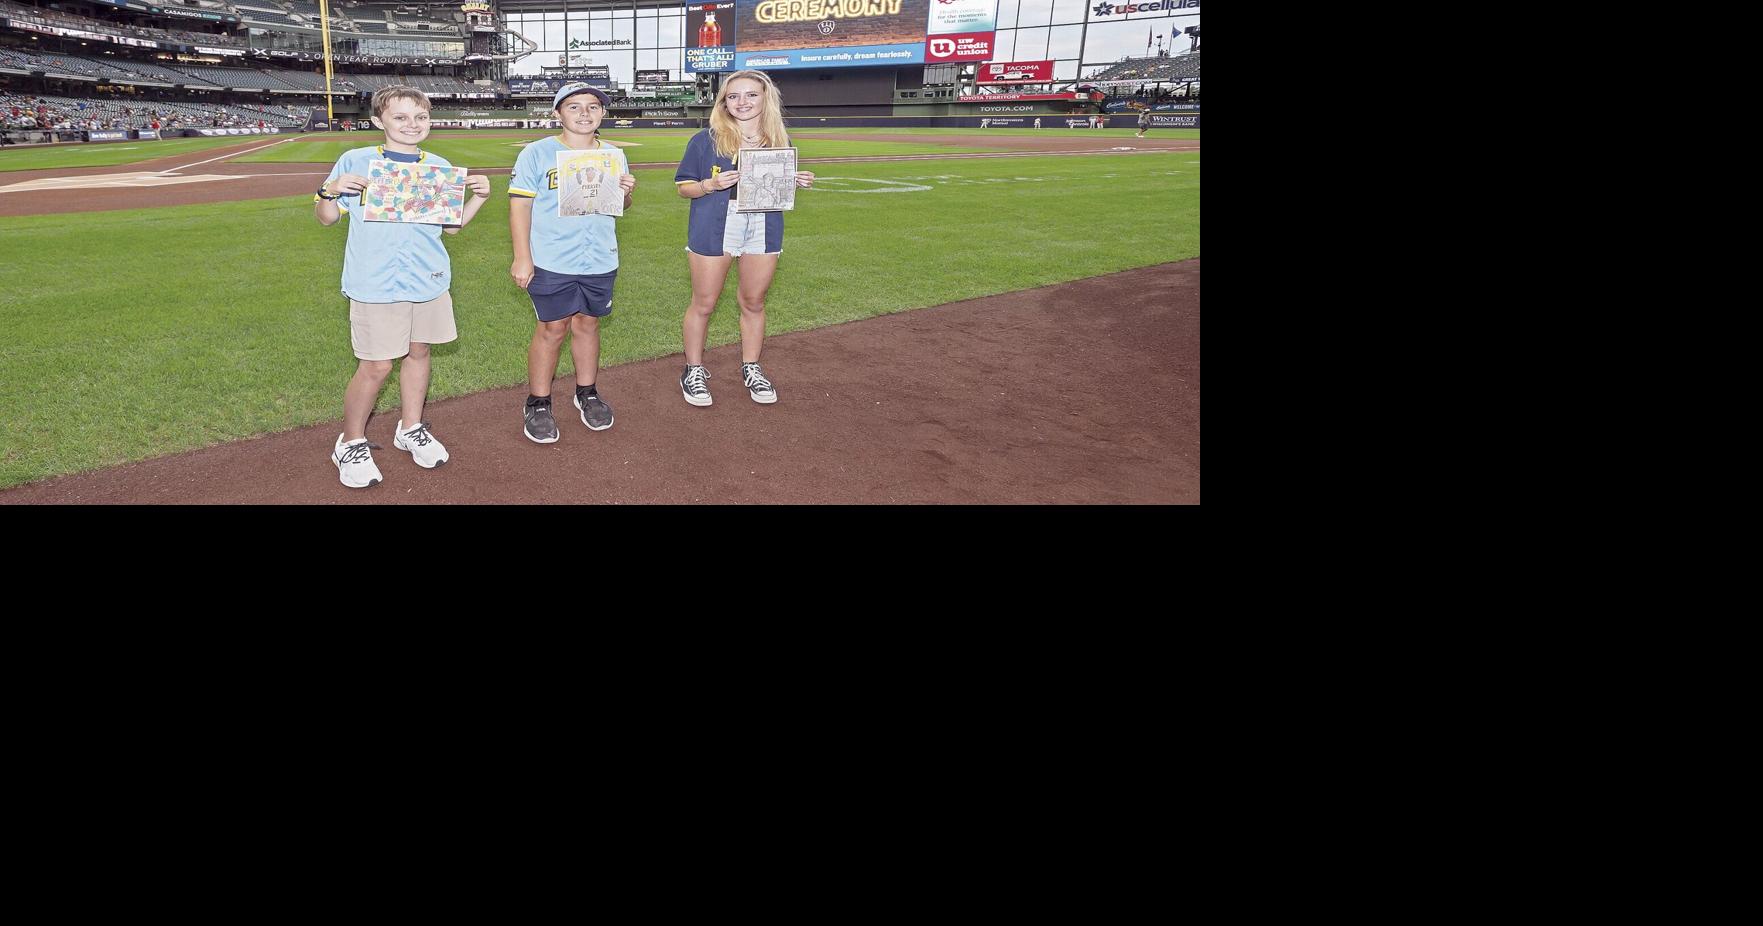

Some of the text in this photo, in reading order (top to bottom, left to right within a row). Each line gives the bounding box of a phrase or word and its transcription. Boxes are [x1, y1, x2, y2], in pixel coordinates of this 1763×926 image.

[164, 9, 202, 18] CASAMIGOS
[755, 0, 903, 23] CEREMONY
[957, 42, 988, 50] credit
[343, 55, 369, 63] YEAR
[822, 53, 853, 61] carefully,
[691, 61, 728, 69] GRUBER
